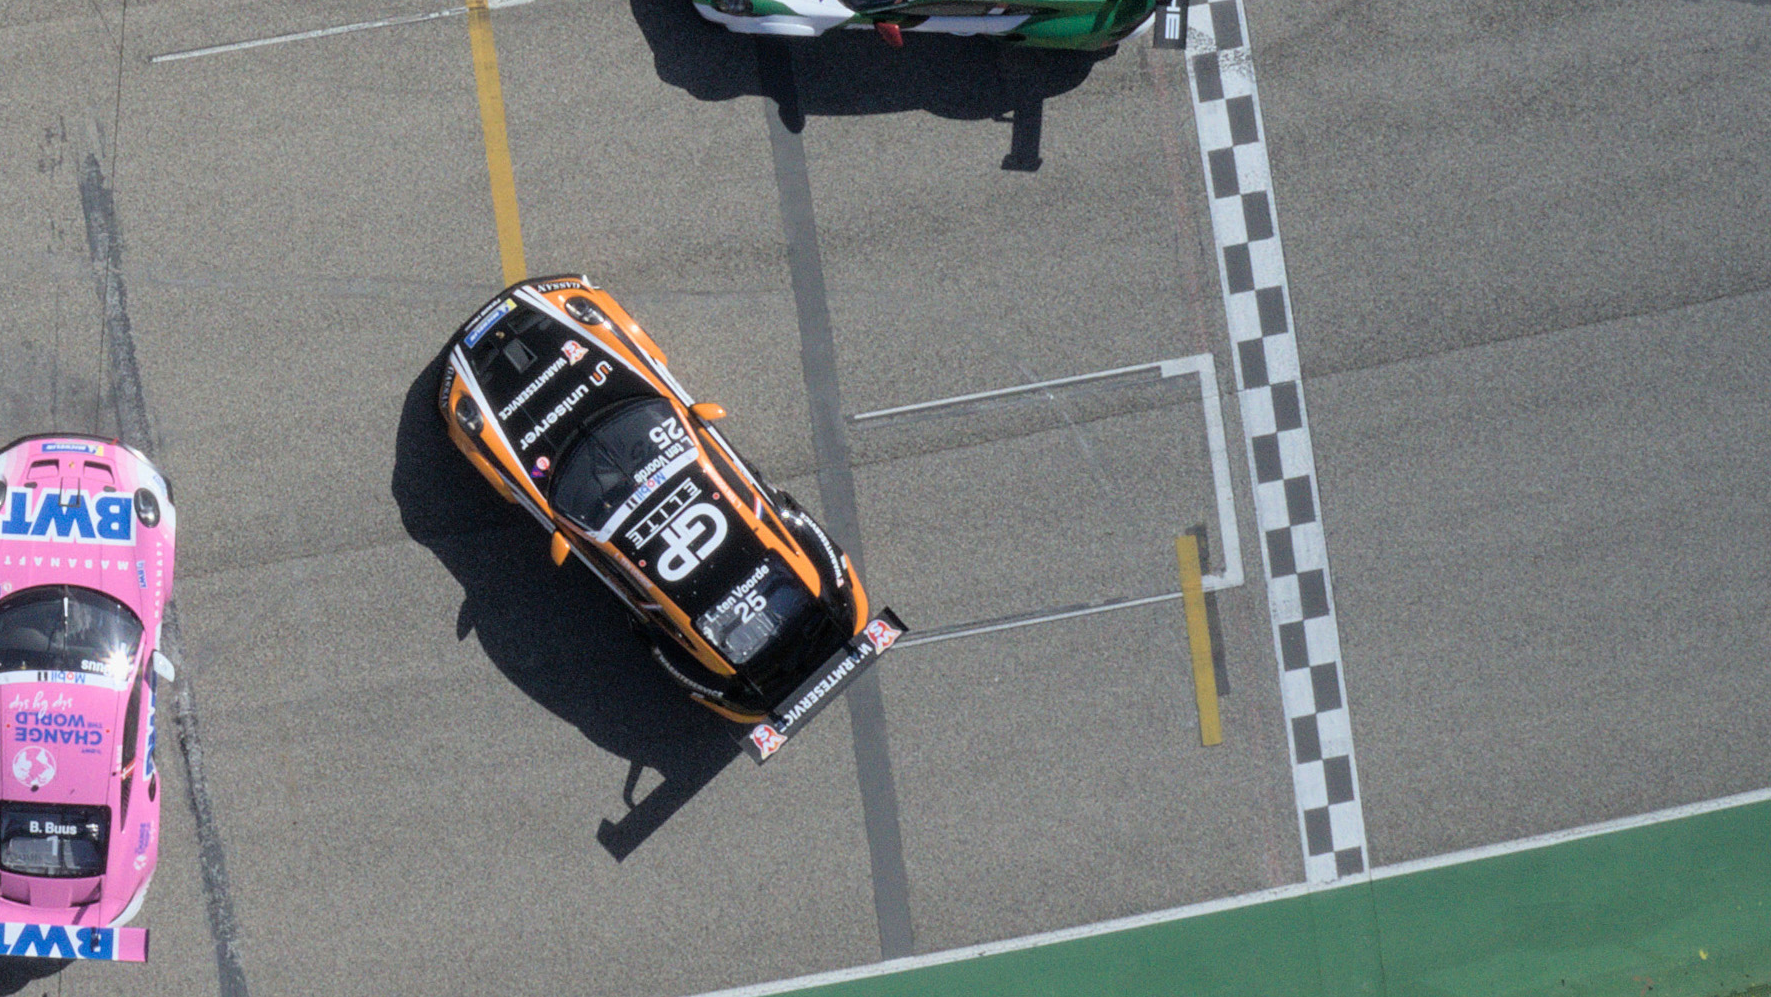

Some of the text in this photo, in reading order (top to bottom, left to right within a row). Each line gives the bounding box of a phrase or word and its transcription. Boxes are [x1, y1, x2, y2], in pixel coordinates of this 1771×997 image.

[536, 280, 580, 291] GASSAN
[497, 356, 566, 420] WARMTESERVICE
[521, 384, 588, 449] uniserver
[648, 416, 684, 449] 25
[633, 435, 695, 484] L. ten Voorde
[632, 469, 666, 501] Mobil
[1, 491, 131, 540] BWT
[625, 480, 700, 545] ELITE
[657, 502, 727, 581] GP
[3, 555, 128, 569] MABANAFT
[703, 564, 769, 624] L. ten Voorde
[733, 589, 766, 624] 25
[50, 670, 85, 682] Mobil
[772, 640, 872, 733] WARMTESERVICE
[8, 690, 72, 718] sip by sip
[15, 711, 84, 727] WORLD
[14, 727, 102, 744] CHANGE
[29, 820, 76, 834] B. Buus
[46, 835, 58, 855] 1
